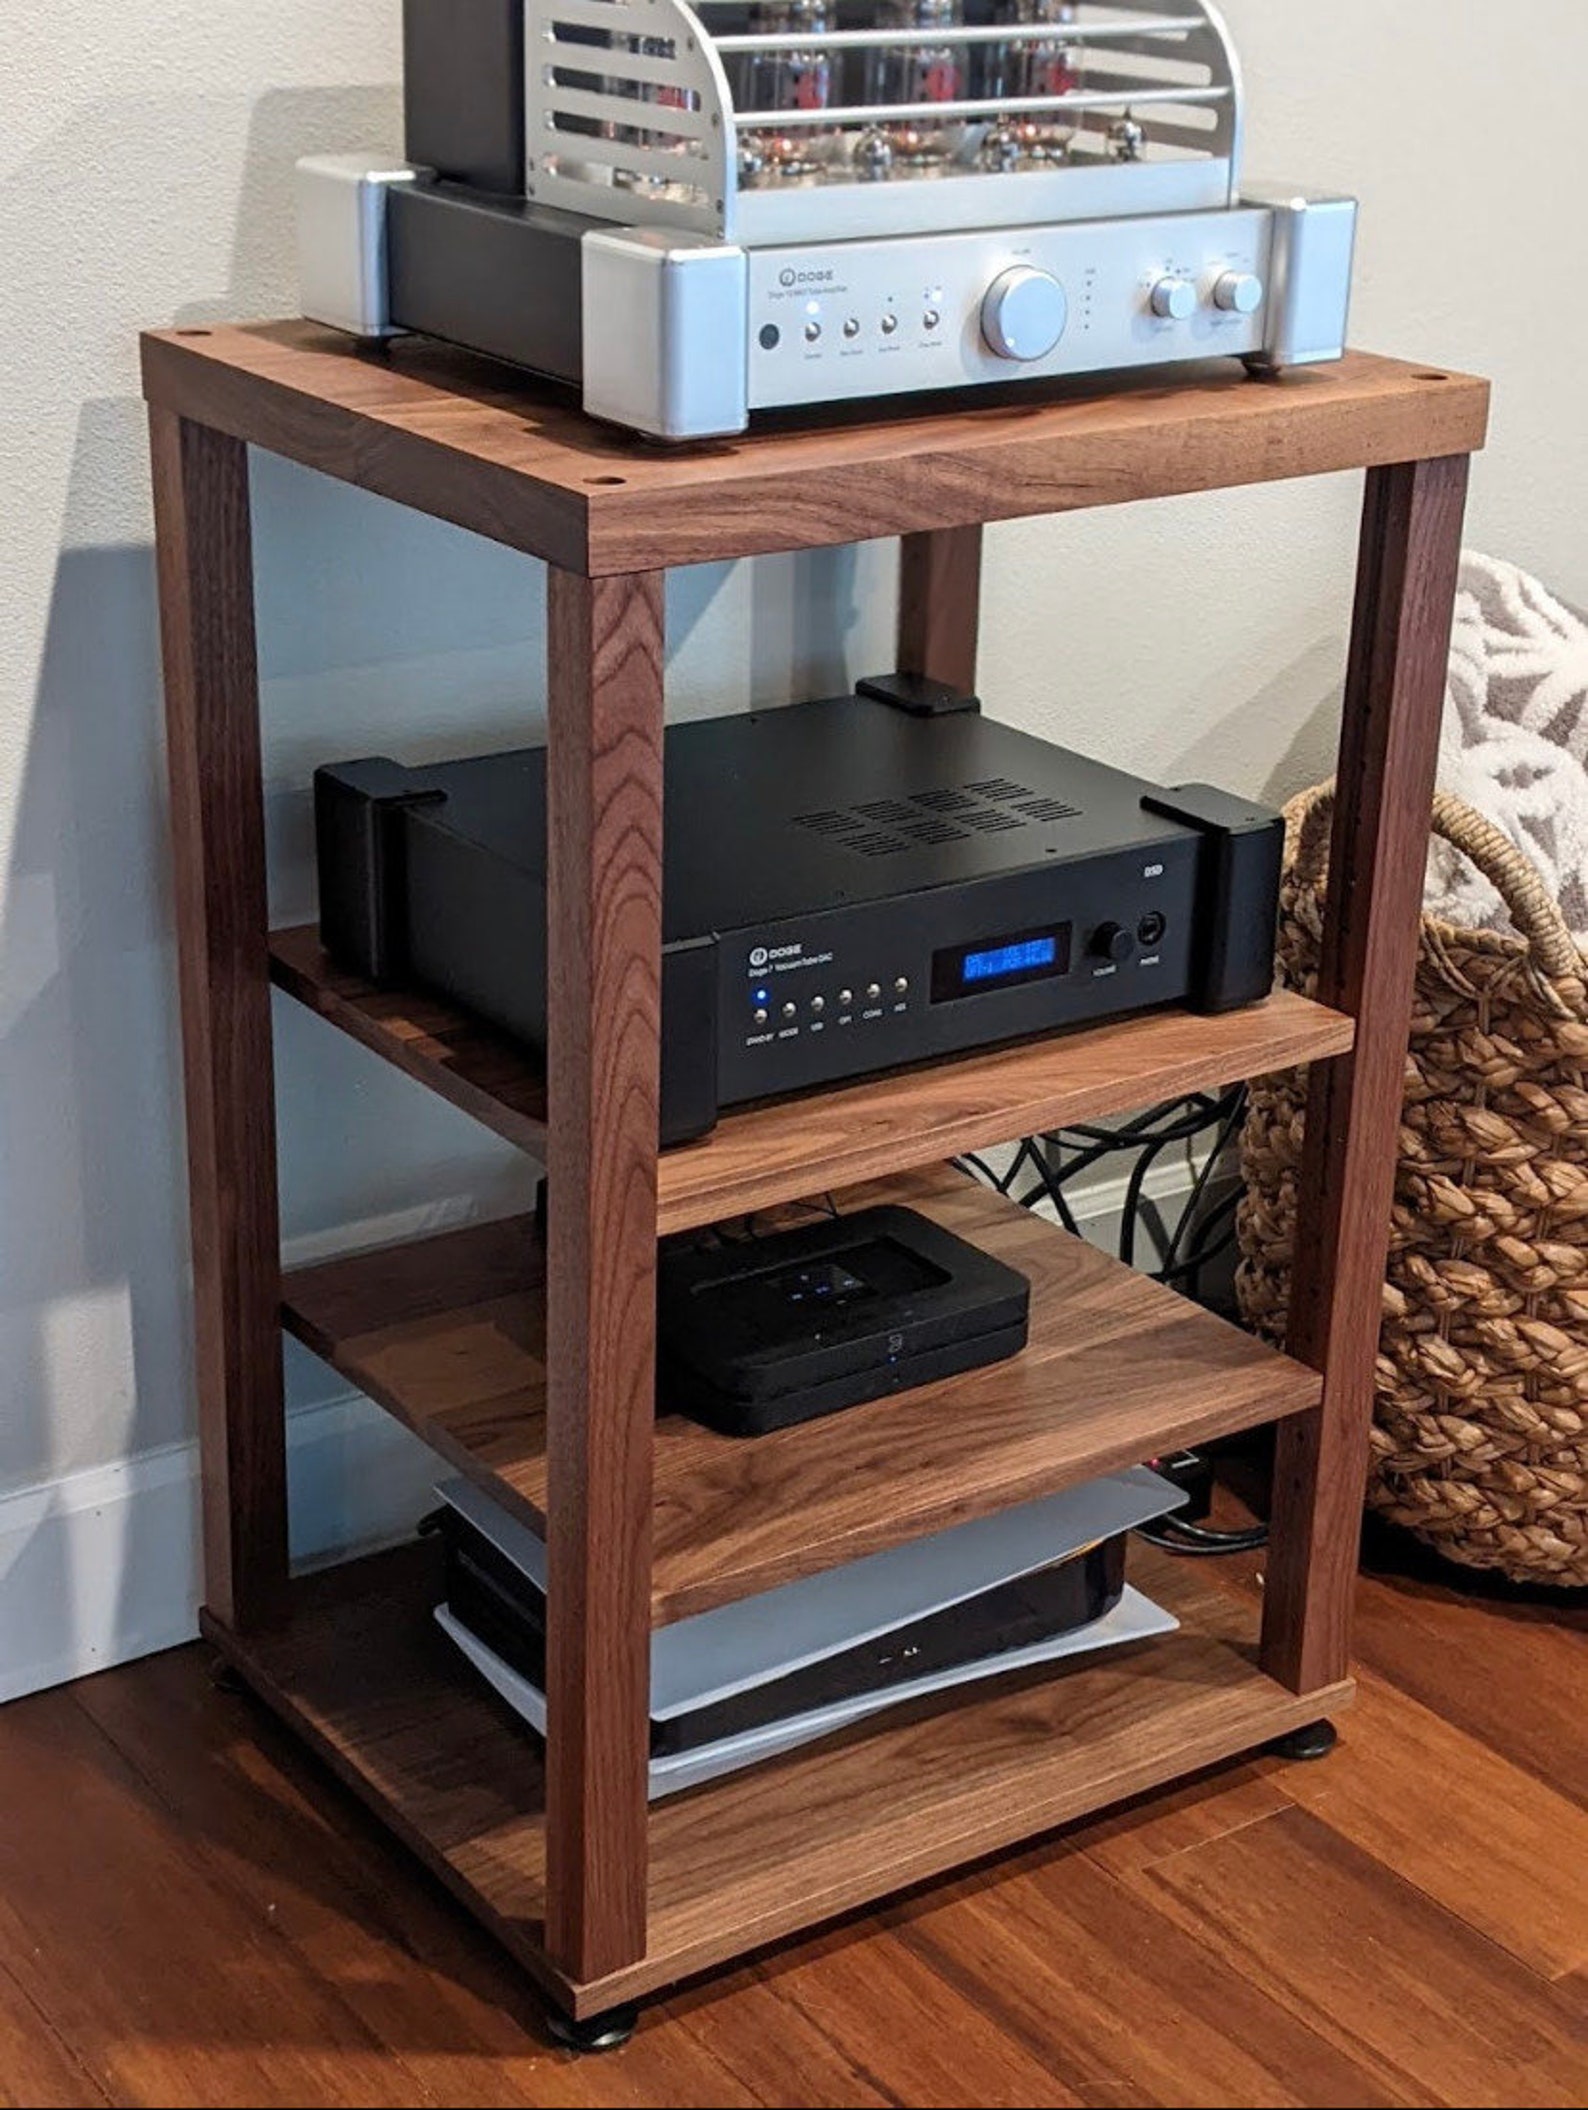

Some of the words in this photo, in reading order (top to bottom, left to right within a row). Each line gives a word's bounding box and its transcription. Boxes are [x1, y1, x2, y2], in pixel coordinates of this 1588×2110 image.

[797, 269, 833, 283] DOGE
[1144, 864, 1163, 877] DSD
[768, 943, 802, 960] DOGE
